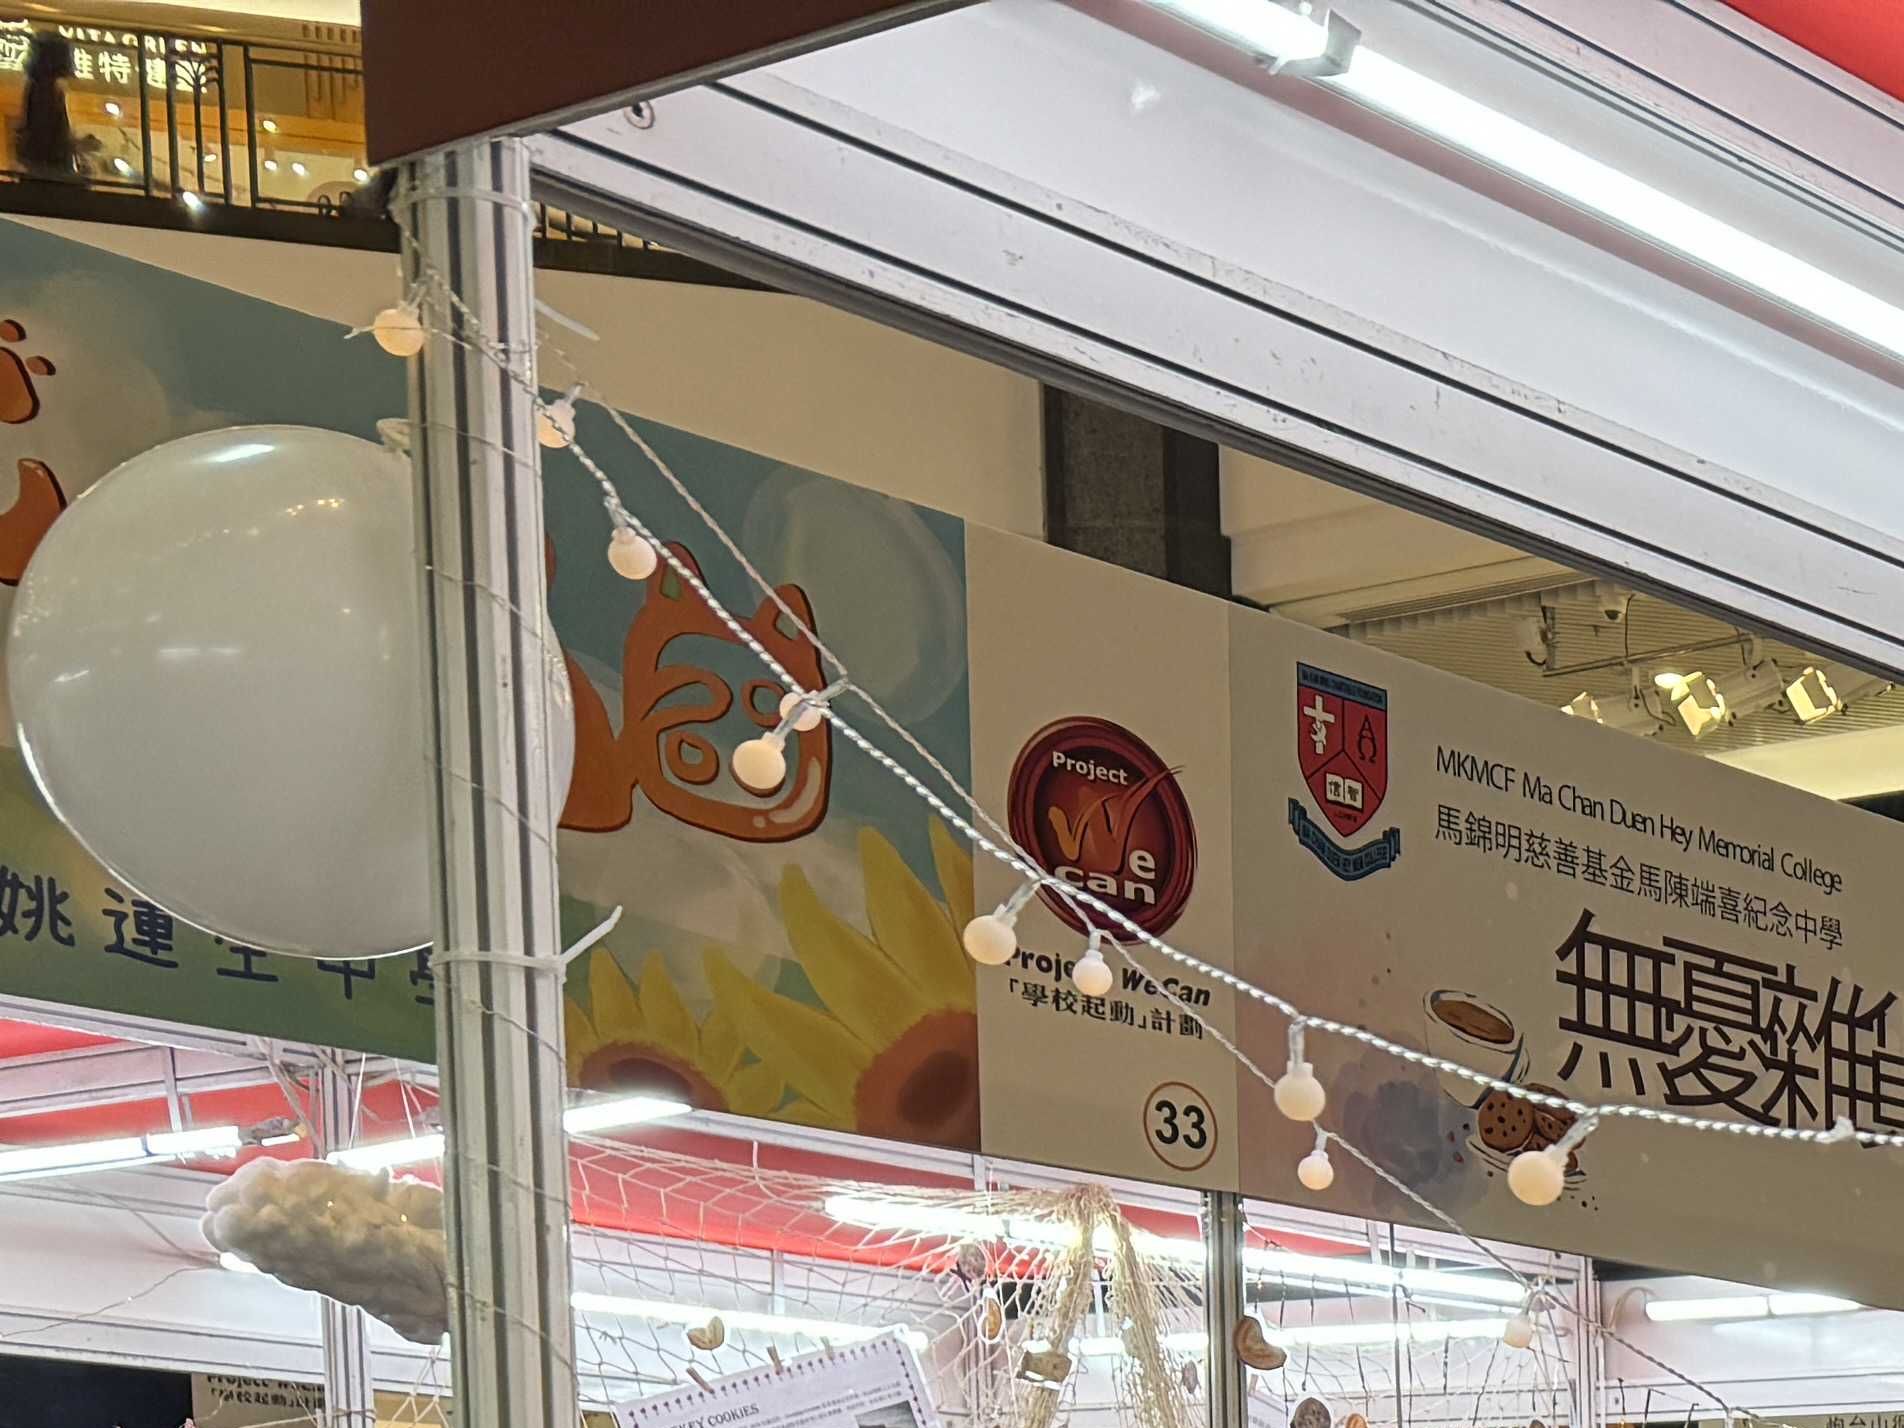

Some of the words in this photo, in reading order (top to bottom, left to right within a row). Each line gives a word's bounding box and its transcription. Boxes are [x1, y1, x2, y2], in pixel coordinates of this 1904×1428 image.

[1053, 750, 1129, 786] Project
[1437, 745, 1515, 793] MKMCF
[1522, 772, 1553, 806] Ma
[1558, 784, 1604, 822] Chan
[1609, 799, 1655, 837] Duen
[1660, 814, 1693, 852] Hey
[1699, 826, 1775, 873] Memorial
[1781, 852, 1843, 896] College
[1054, 865, 1156, 905] can
[1435, 804, 1843, 951] 馬錦明慈善基金馬陳端喜紀念中學
[1121, 966, 1211, 1007] WeCan
[1154, 1099, 1208, 1150] 33
[707, 1402, 760, 1428] COOKIES
